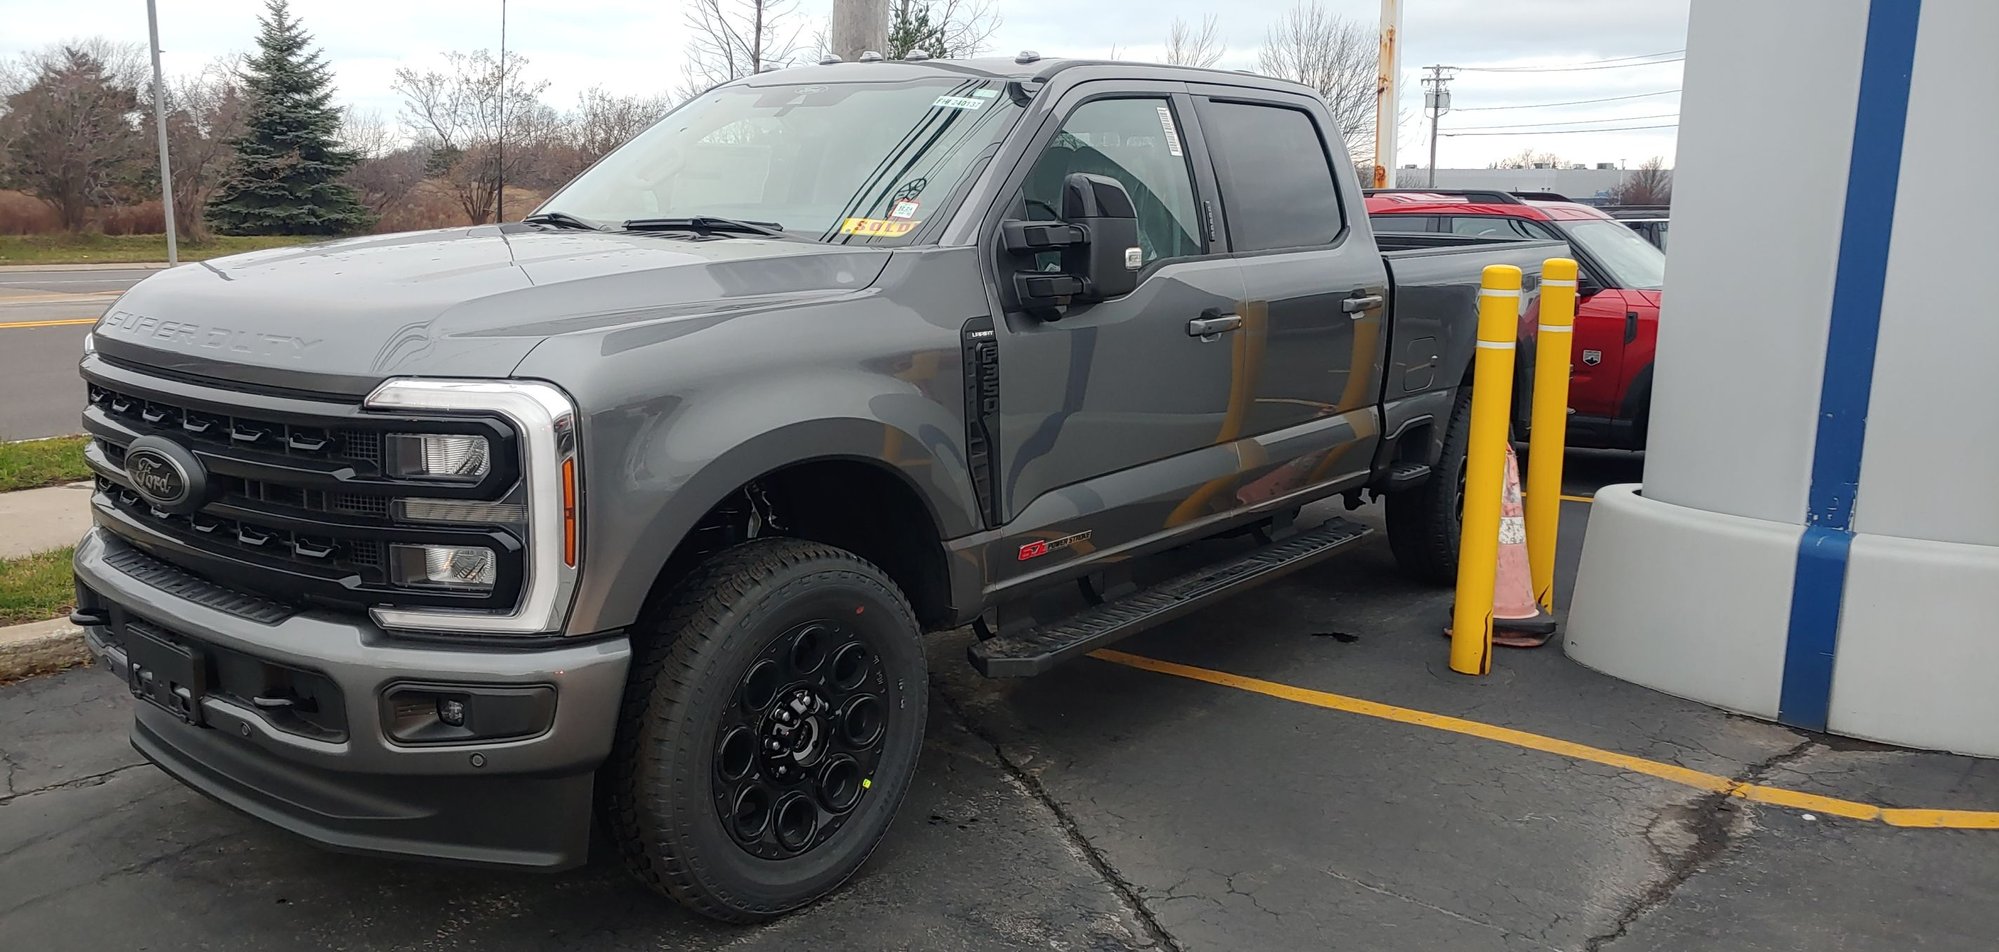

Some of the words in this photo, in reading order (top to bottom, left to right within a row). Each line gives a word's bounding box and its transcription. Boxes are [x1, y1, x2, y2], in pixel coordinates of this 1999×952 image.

[854, 220, 911, 233] SOLD
[107, 310, 200, 345] SUPER
[200, 326, 324, 359] DUTY
[135, 457, 172, 494] Ford
